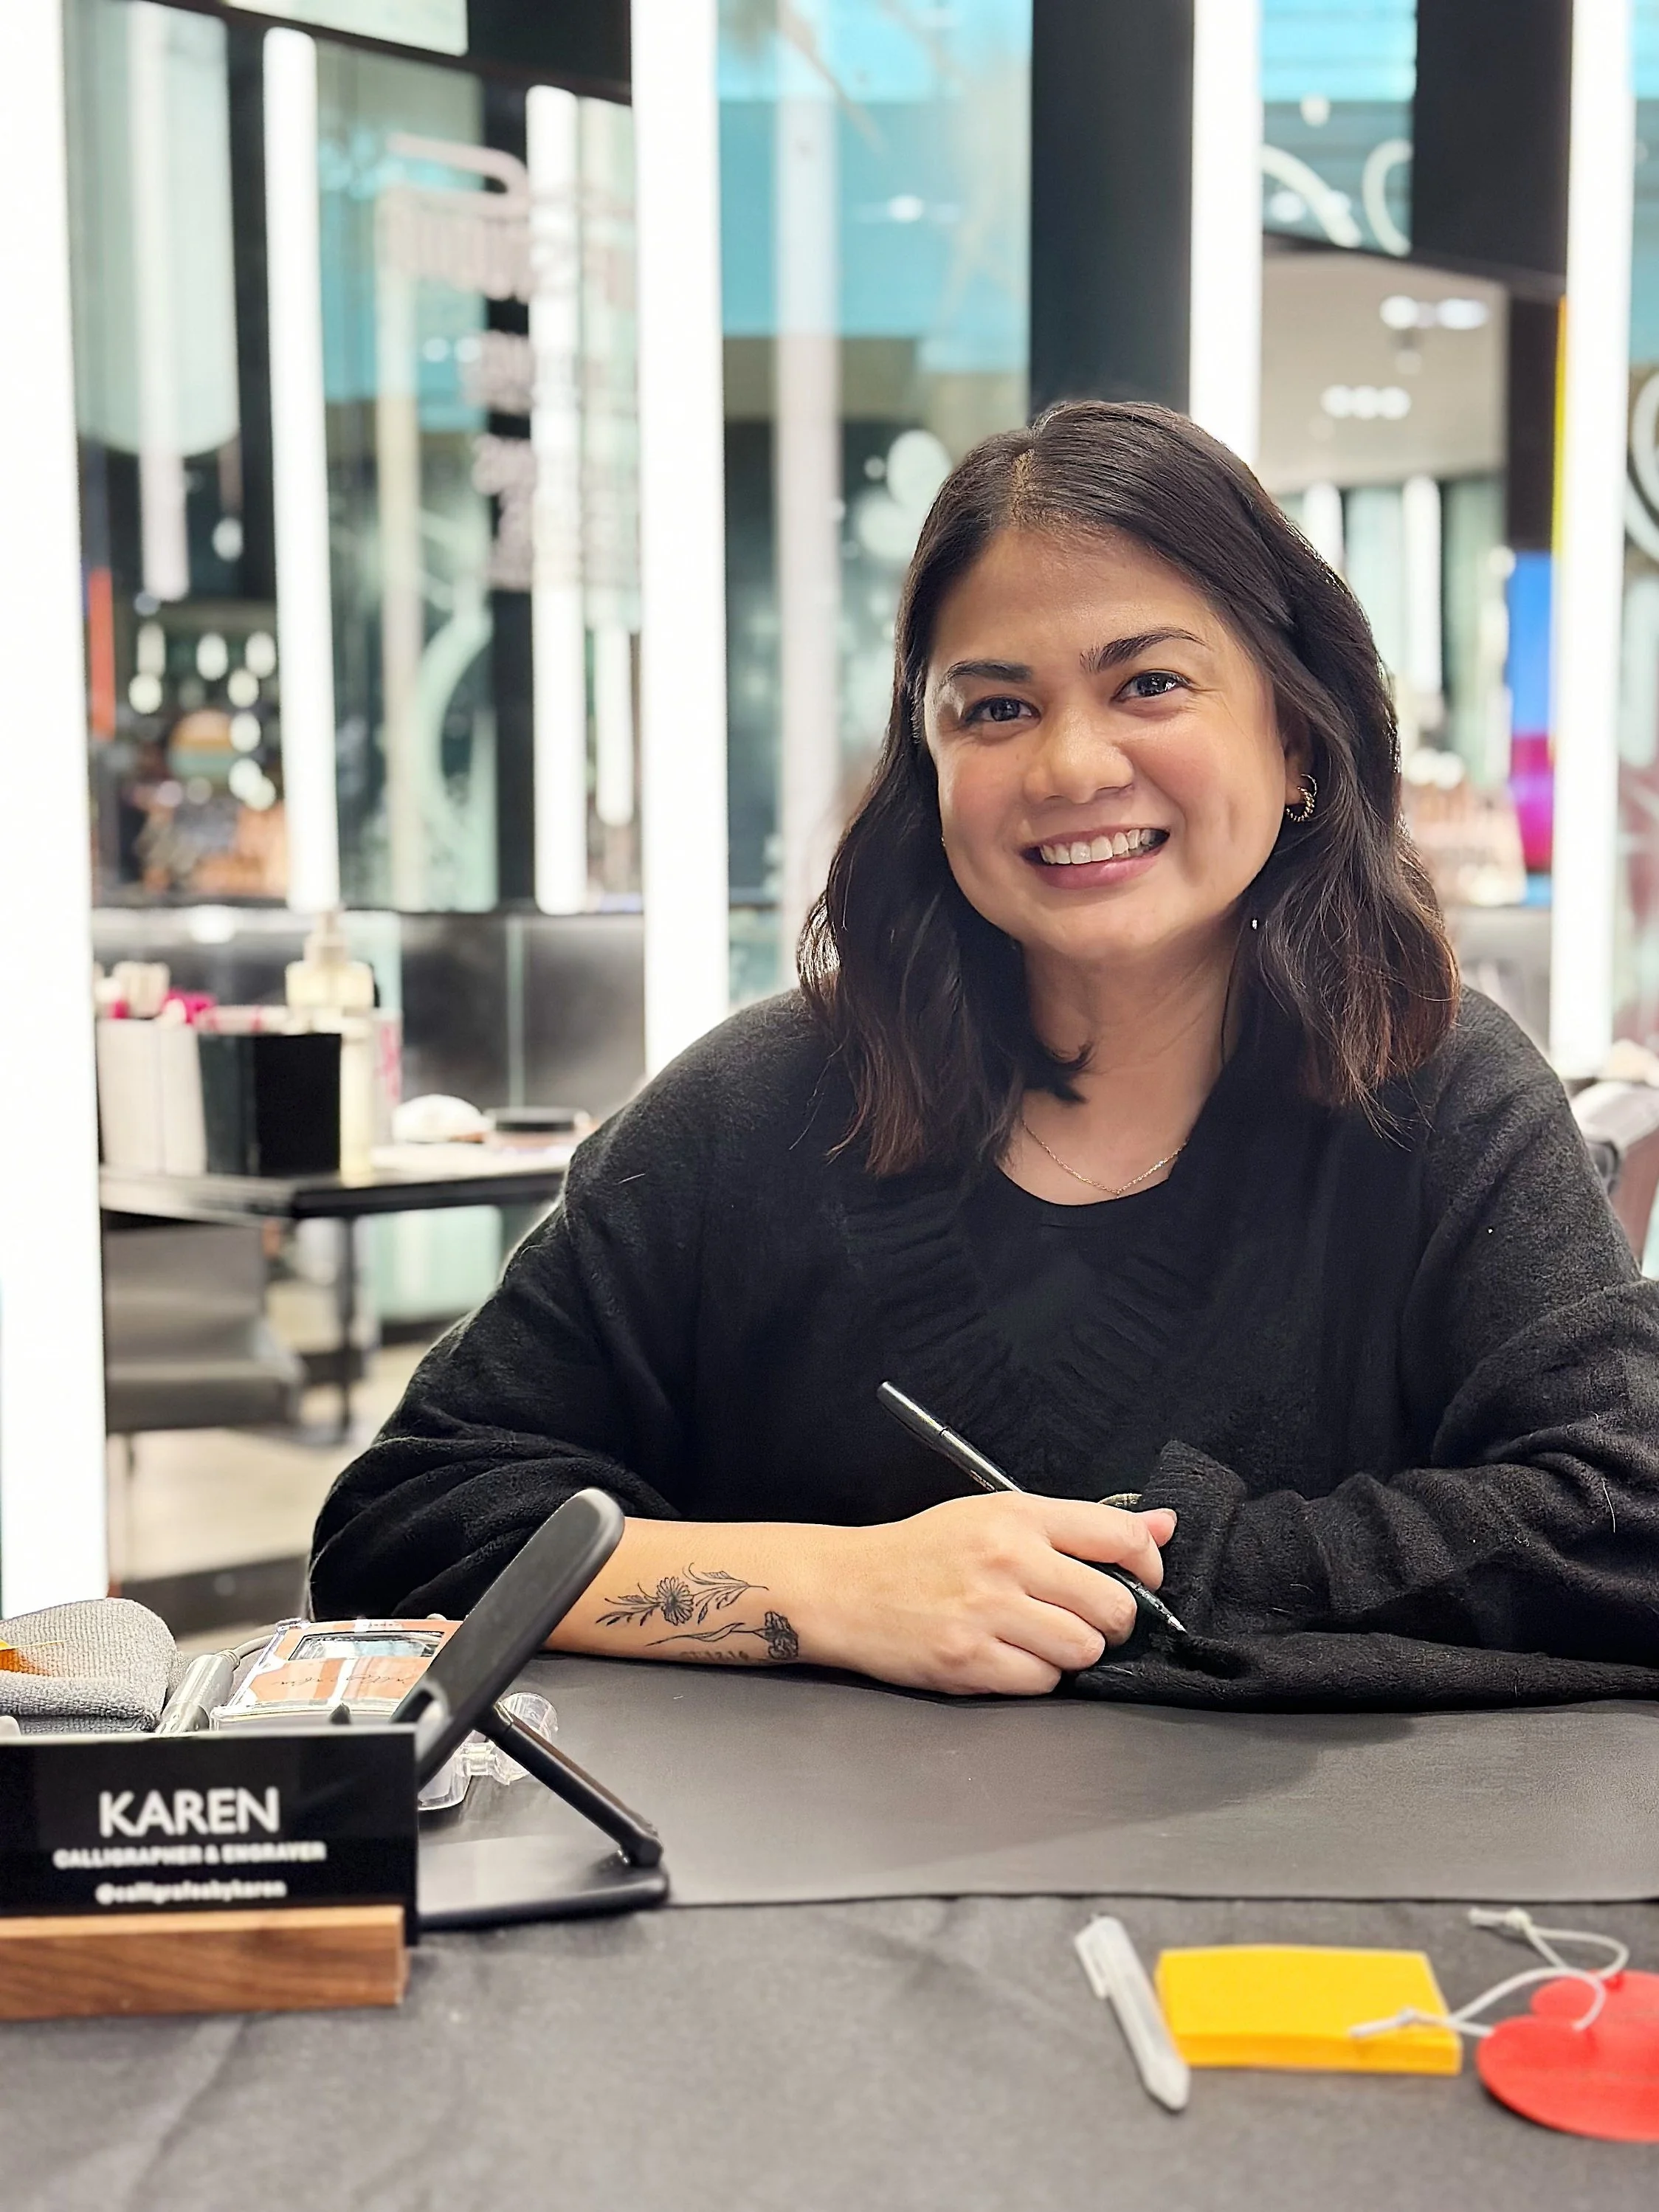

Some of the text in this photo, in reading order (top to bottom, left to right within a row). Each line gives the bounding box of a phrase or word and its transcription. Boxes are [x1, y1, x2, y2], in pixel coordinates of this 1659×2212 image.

[99, 1787, 280, 1838] KAREN
[52, 1841, 326, 1870] CALLIGRAPHER & ENGRAVER
